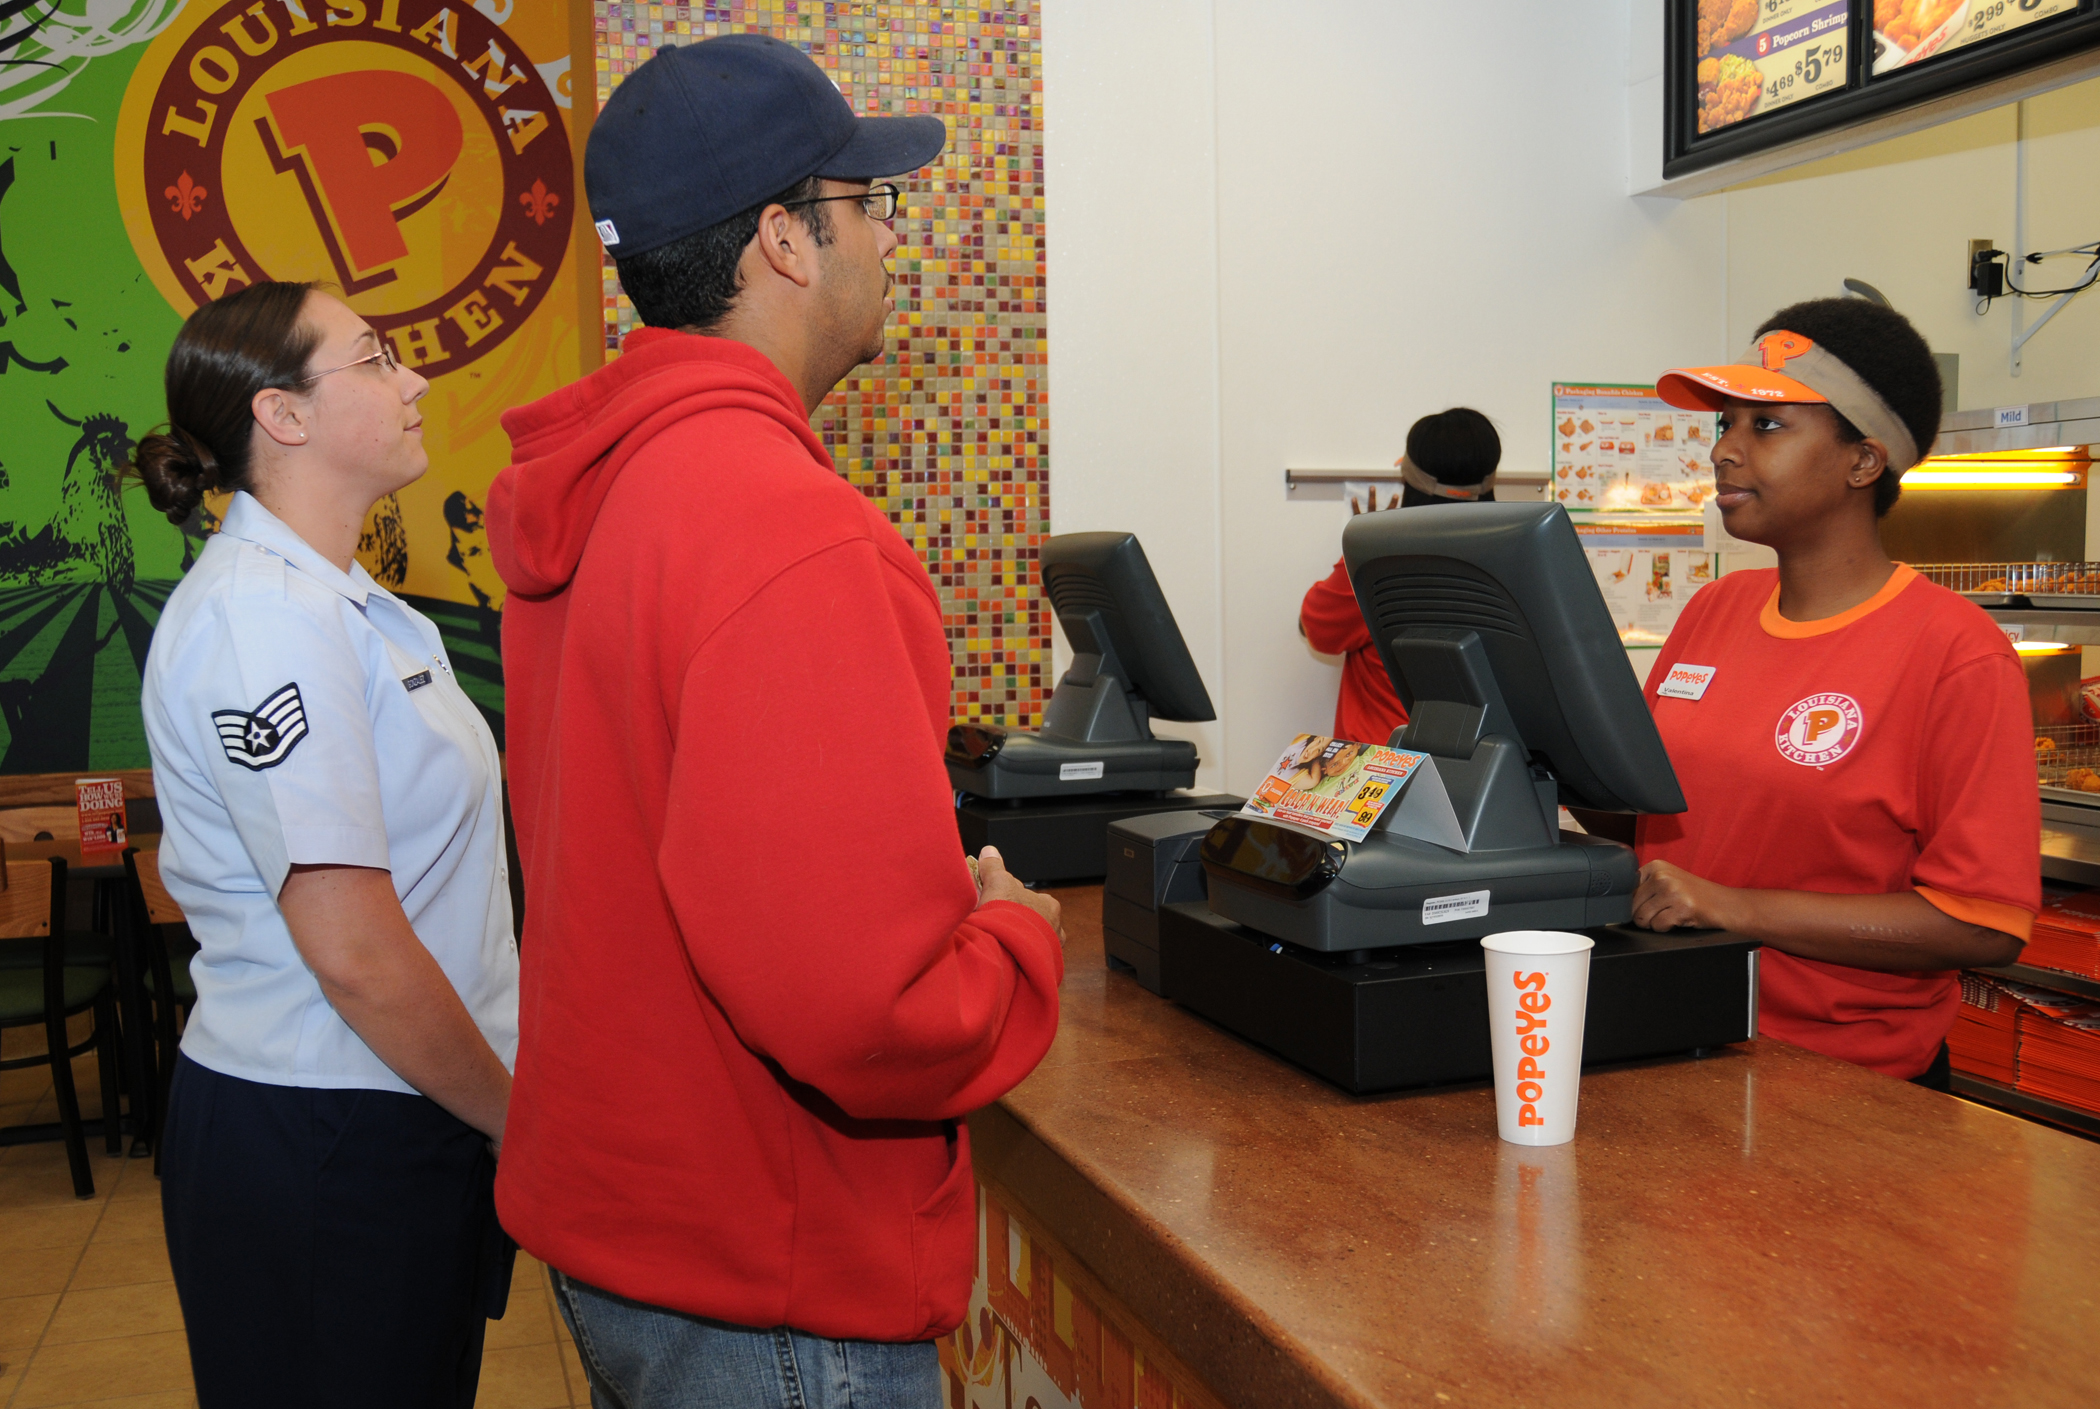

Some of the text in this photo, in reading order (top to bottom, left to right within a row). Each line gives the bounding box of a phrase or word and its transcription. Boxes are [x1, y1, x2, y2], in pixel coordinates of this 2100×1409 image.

[1763, 7, 1793, 24] DINNER ONLY
[2034, 5, 2058, 19] COMBO
[1759, 12, 1848, 52] 5 Popcorn Shrimp
[1960, 23, 2006, 44] NUGGETS ONLY
[162, 0, 549, 155] LOUISIANA
[1815, 80, 1833, 91] COMBO
[1764, 94, 1794, 108] DINNER ONLY
[254, 69, 464, 297] P
[184, 239, 544, 366] KHEN
[1758, 329, 1815, 372] P
[1750, 388, 1784, 398] 1972
[2000, 410, 2022, 423] Mild
[1788, 695, 1858, 730] LOUISIANA
[1803, 709, 1840, 746] P
[1779, 733, 1843, 763] KITCHEN
[80, 792, 104, 802] HOW
[103, 781, 123, 794] US
[80, 799, 123, 811] DOING
